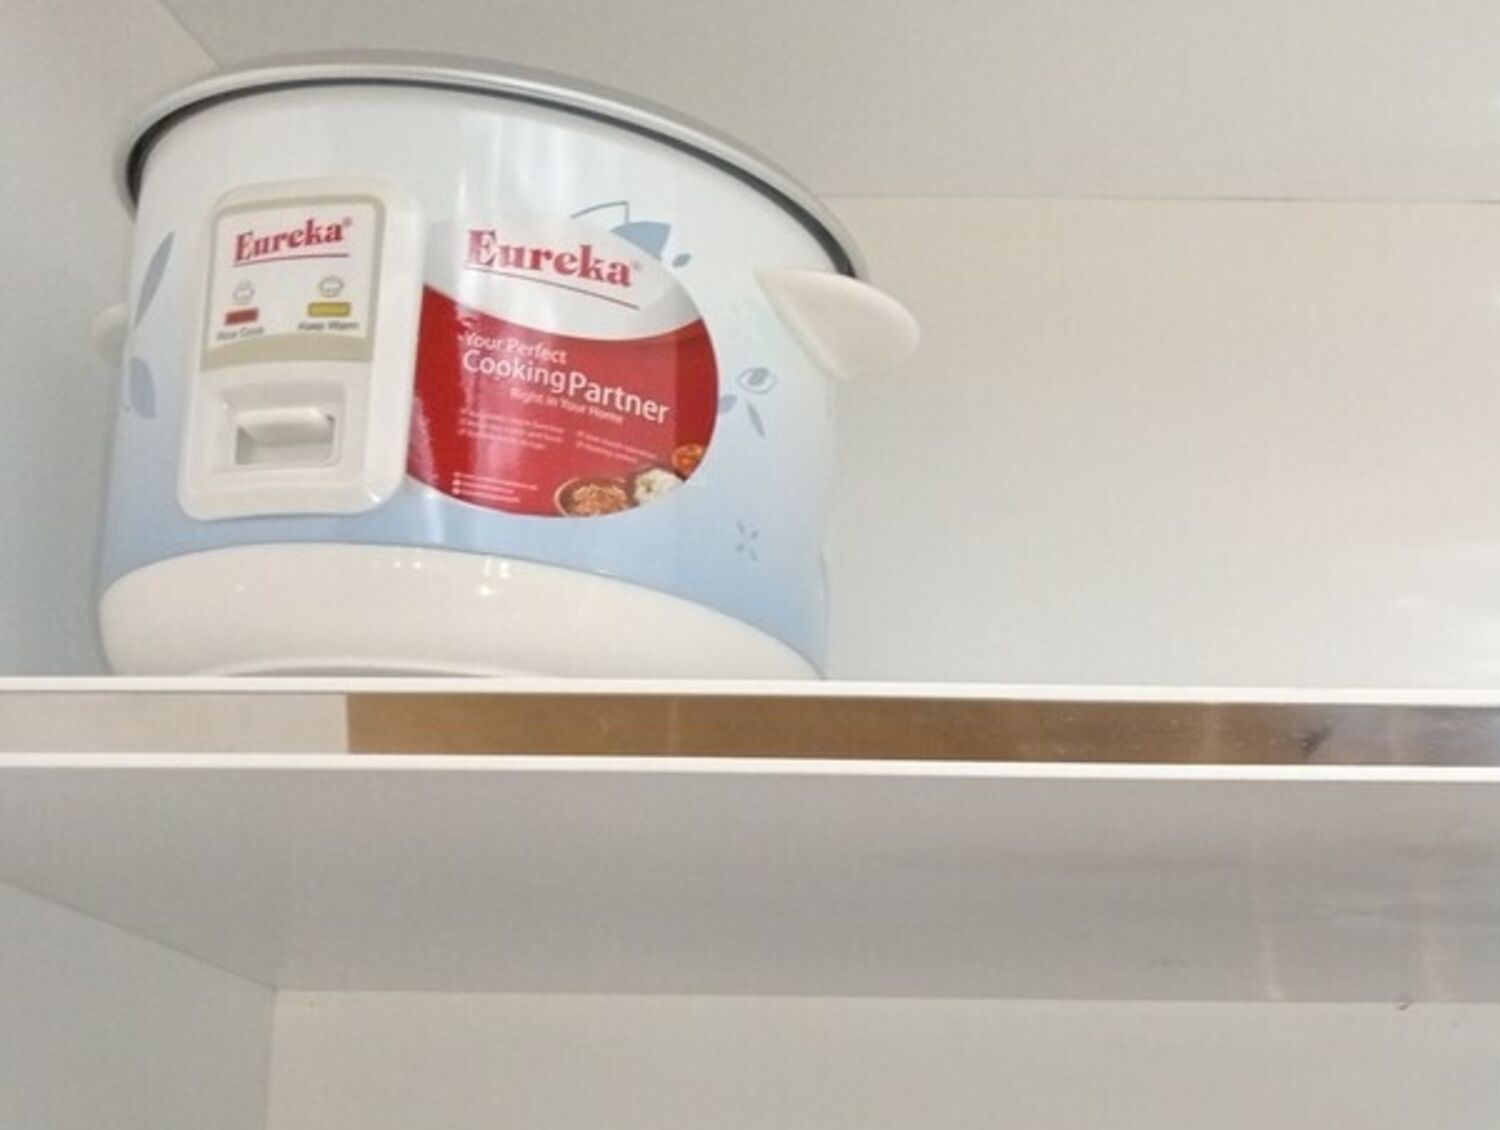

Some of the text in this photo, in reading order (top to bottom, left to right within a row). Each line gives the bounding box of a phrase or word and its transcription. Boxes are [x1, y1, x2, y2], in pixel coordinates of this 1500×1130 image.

[235, 217, 343, 261] Eureka
[466, 229, 631, 287] Eureka
[464, 330, 567, 365] Your Perfect
